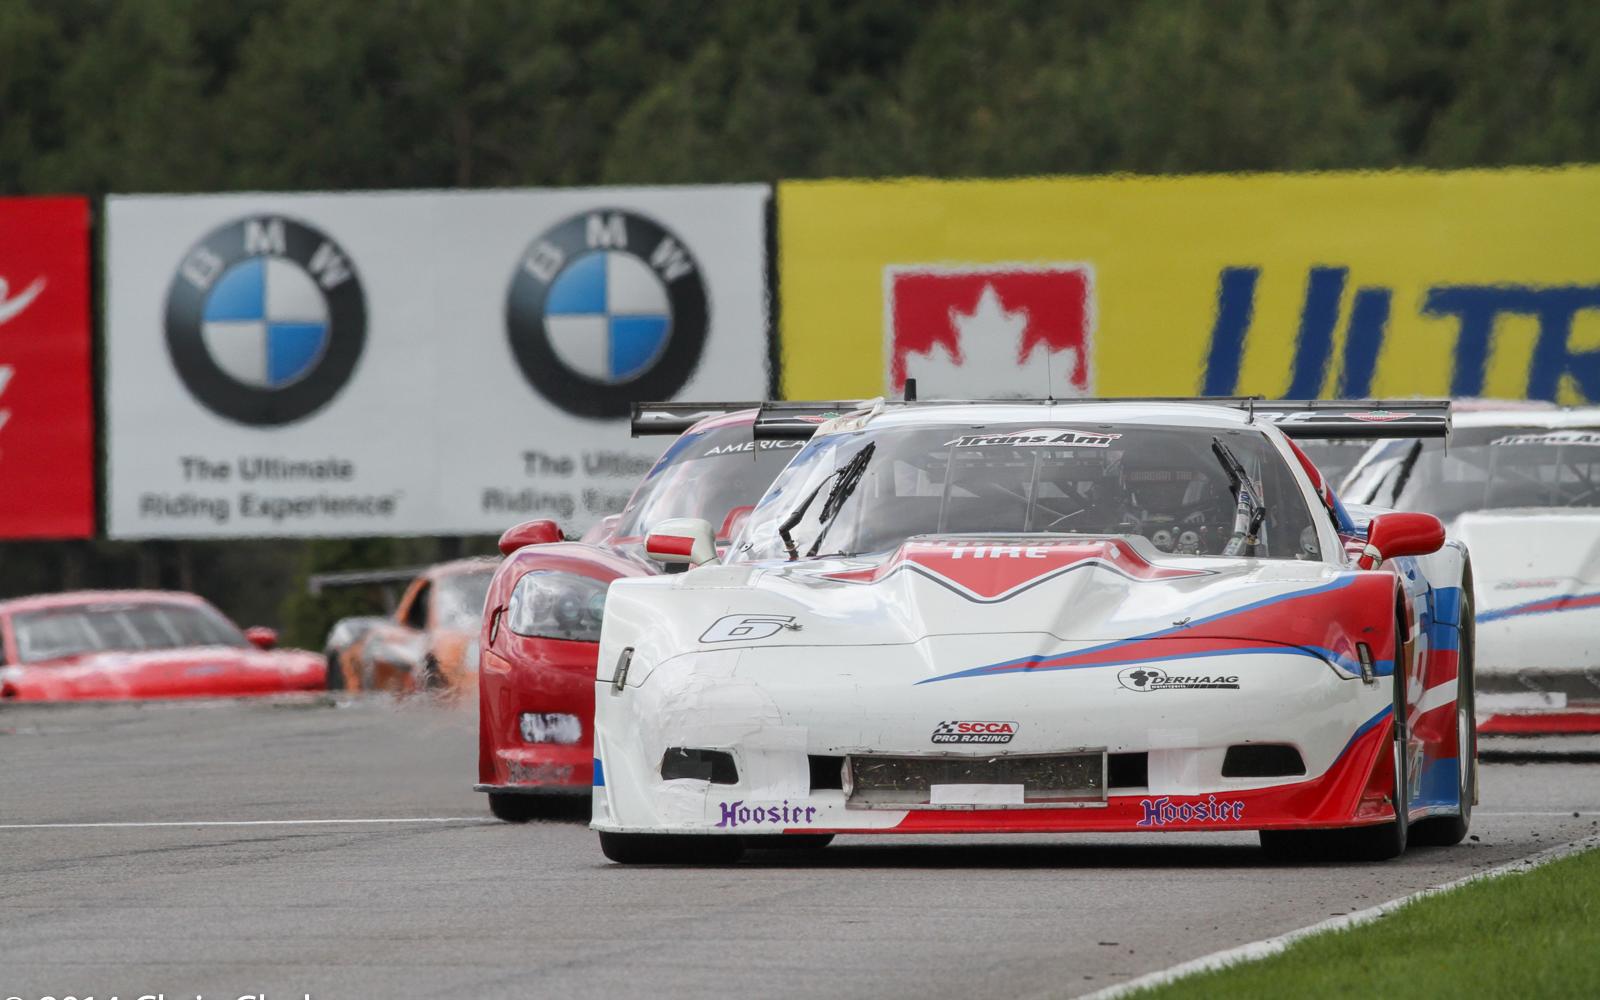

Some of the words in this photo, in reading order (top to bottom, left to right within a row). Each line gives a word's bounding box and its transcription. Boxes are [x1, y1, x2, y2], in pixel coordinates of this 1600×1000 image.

[182, 219, 350, 290] BMW
[525, 213, 693, 284] BMW
[956, 436, 1047, 446] Trans
[180, 455, 232, 482] The
[238, 457, 356, 482] Ultimate
[522, 452, 574, 477] The
[140, 492, 230, 524] Riding
[482, 488, 575, 519] Riding
[698, 613, 796, 643] 6
[1151, 676, 1239, 684] DERHAAG
[933, 734, 959, 743] PRO
[961, 734, 1010, 743] RACING
[958, 723, 1013, 733] SCCA
[714, 800, 816, 828] Hoosier
[1137, 795, 1245, 827] Hoosier
